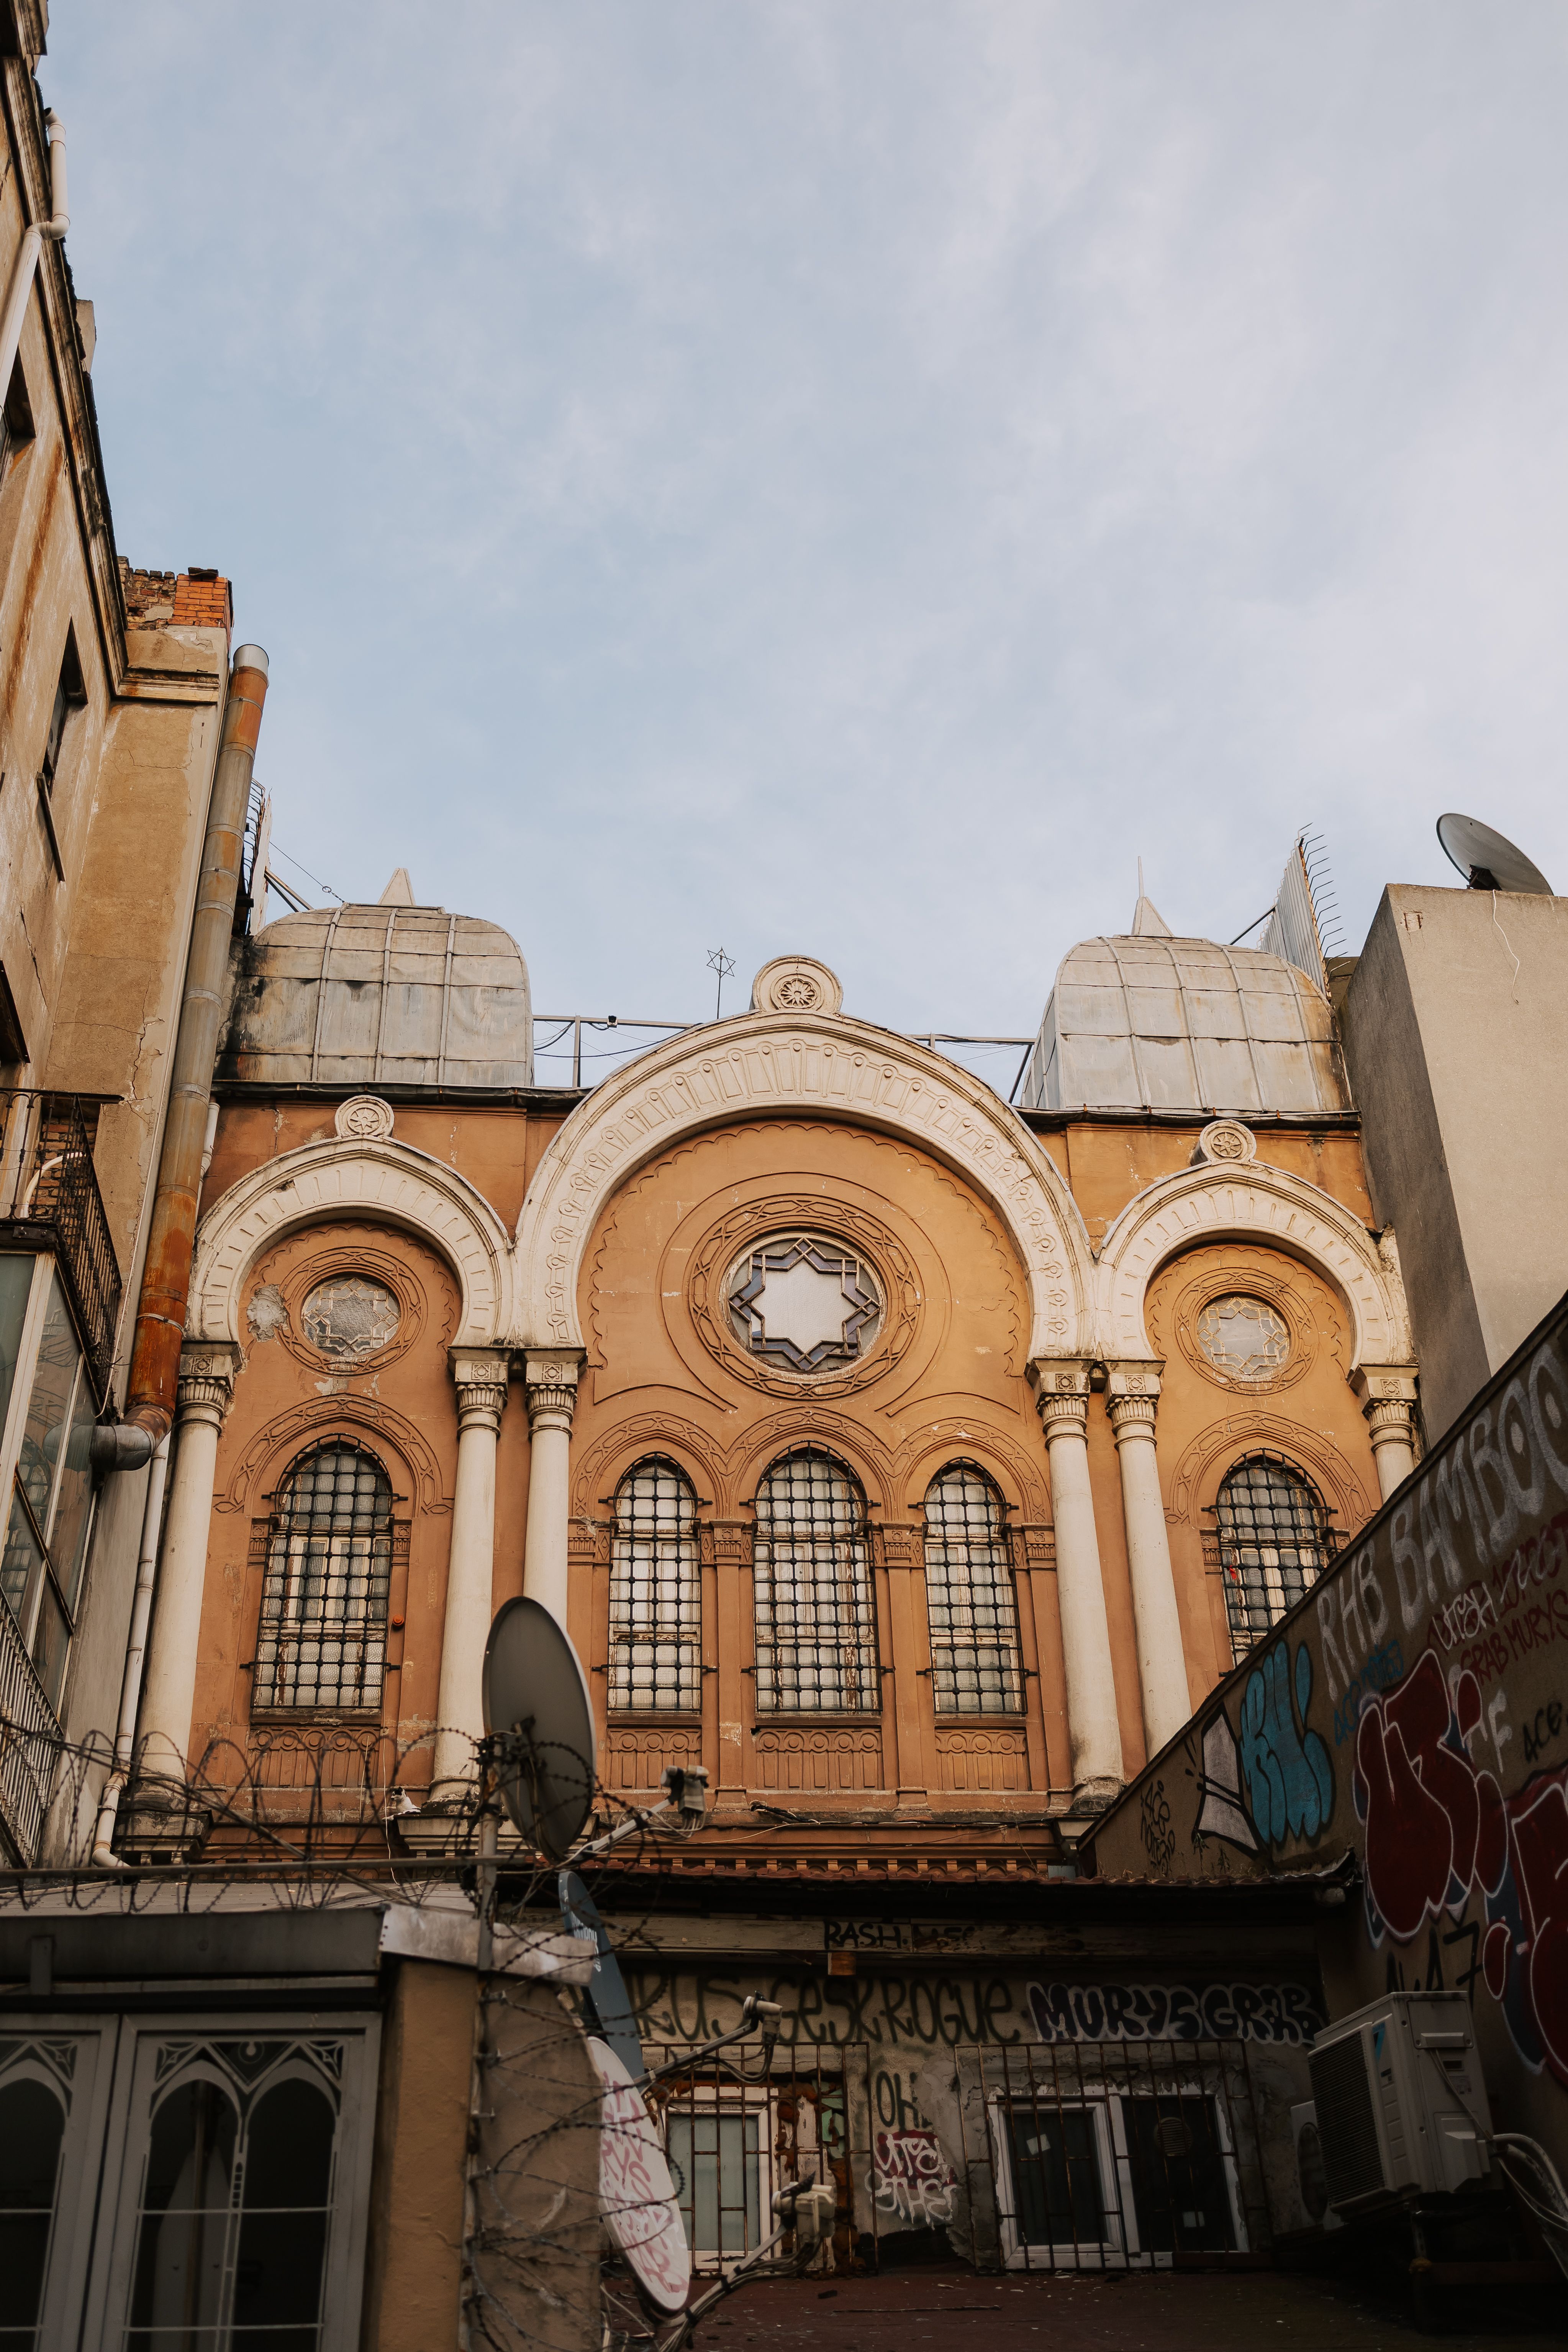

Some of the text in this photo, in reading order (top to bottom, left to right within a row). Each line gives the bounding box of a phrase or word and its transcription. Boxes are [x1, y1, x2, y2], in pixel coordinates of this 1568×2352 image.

[1316, 1536, 1389, 1701] RHB
[1389, 1344, 1568, 1632] BAMBOO
[1460, 1589, 1568, 1685] GRAB MURYS
